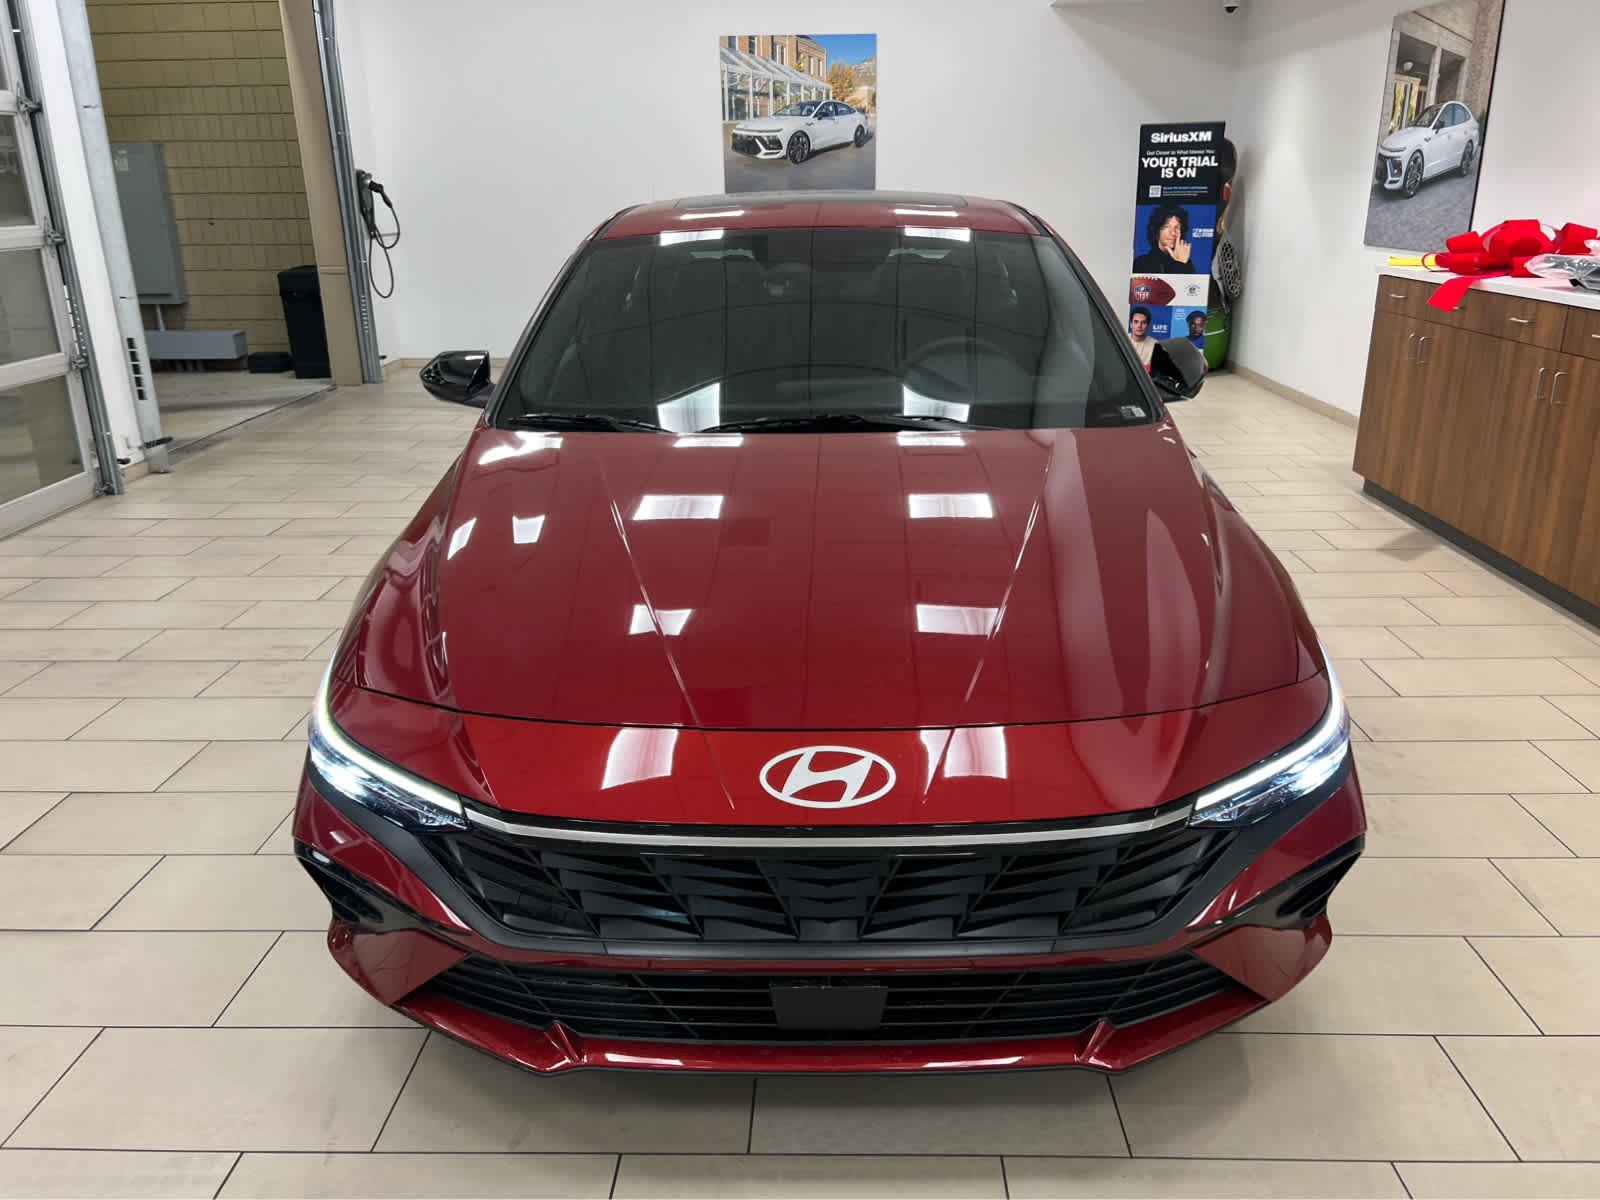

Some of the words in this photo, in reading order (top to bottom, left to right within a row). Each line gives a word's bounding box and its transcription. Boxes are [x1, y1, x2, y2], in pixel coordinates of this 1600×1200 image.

[1150, 131, 1212, 143] SiriusXM
[1141, 157, 1178, 168] YOUR
[1180, 155, 1219, 167] TRIAL
[1161, 168, 1174, 178] IS
[1176, 167, 1197, 178] ON
